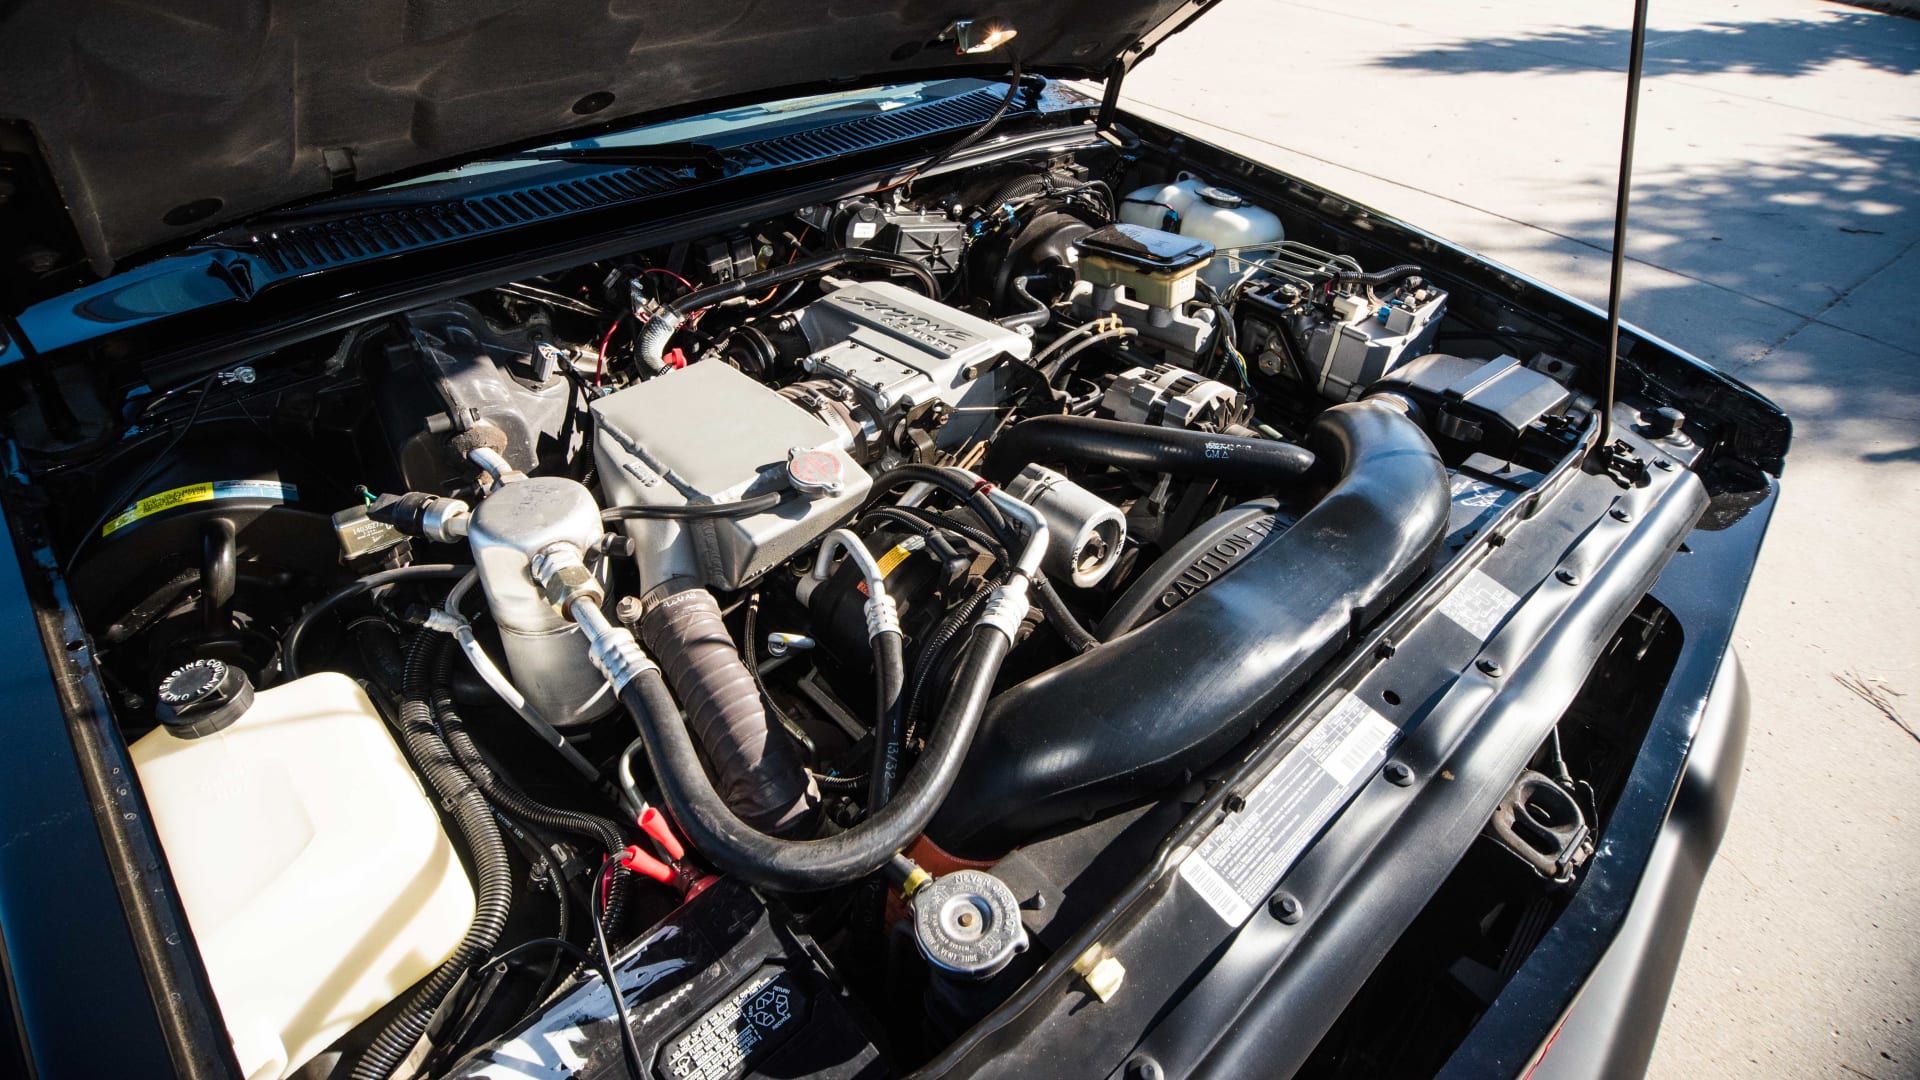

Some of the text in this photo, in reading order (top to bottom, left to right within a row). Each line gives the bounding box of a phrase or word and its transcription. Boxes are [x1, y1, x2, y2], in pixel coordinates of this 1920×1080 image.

[833, 295, 972, 342] SYCLONE
[908, 328, 958, 352] TURBO
[159, 658, 226, 702] ENGINE COOLANT ONLY
[953, 873, 992, 887] NEVER
[992, 884, 1013, 907] OPEN
[725, 1029, 738, 1041] FAST
[772, 1013, 792, 1031] RECYCLE
